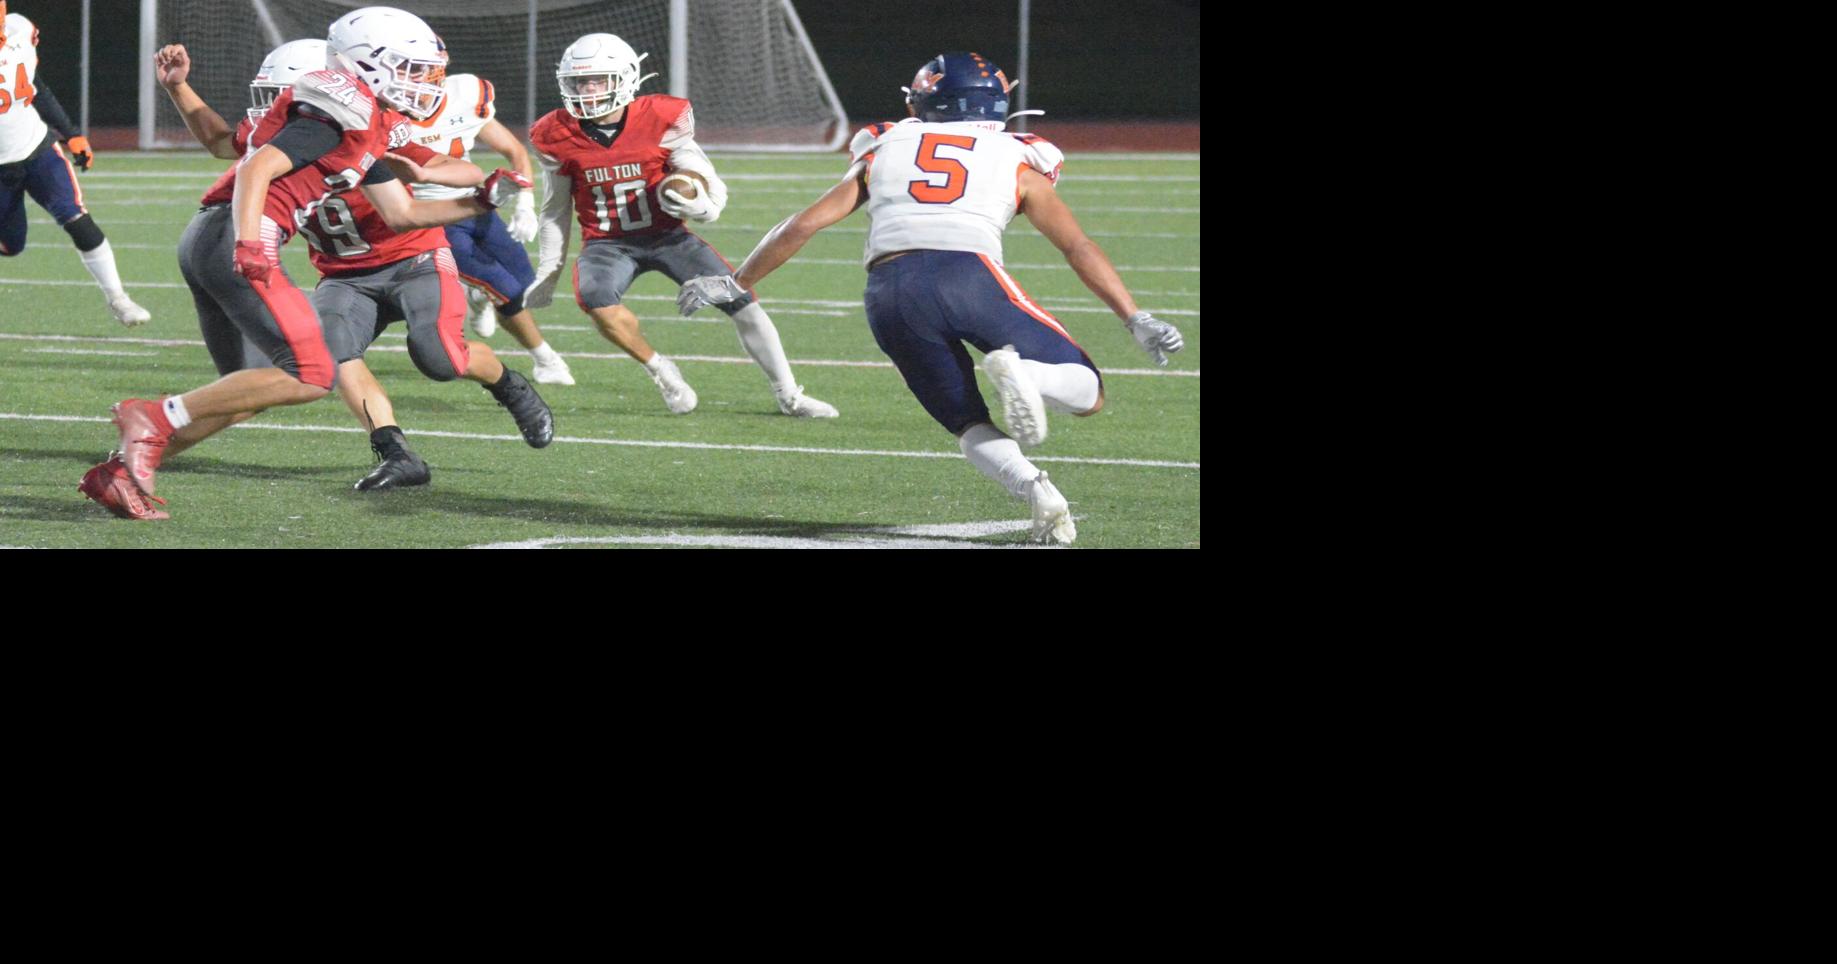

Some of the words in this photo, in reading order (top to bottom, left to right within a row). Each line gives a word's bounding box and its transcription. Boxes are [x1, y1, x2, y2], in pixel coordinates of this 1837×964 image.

[316, 73, 357, 106] 24
[584, 162, 641, 183] FULTON
[907, 132, 977, 205] 5
[591, 179, 652, 232] 10
